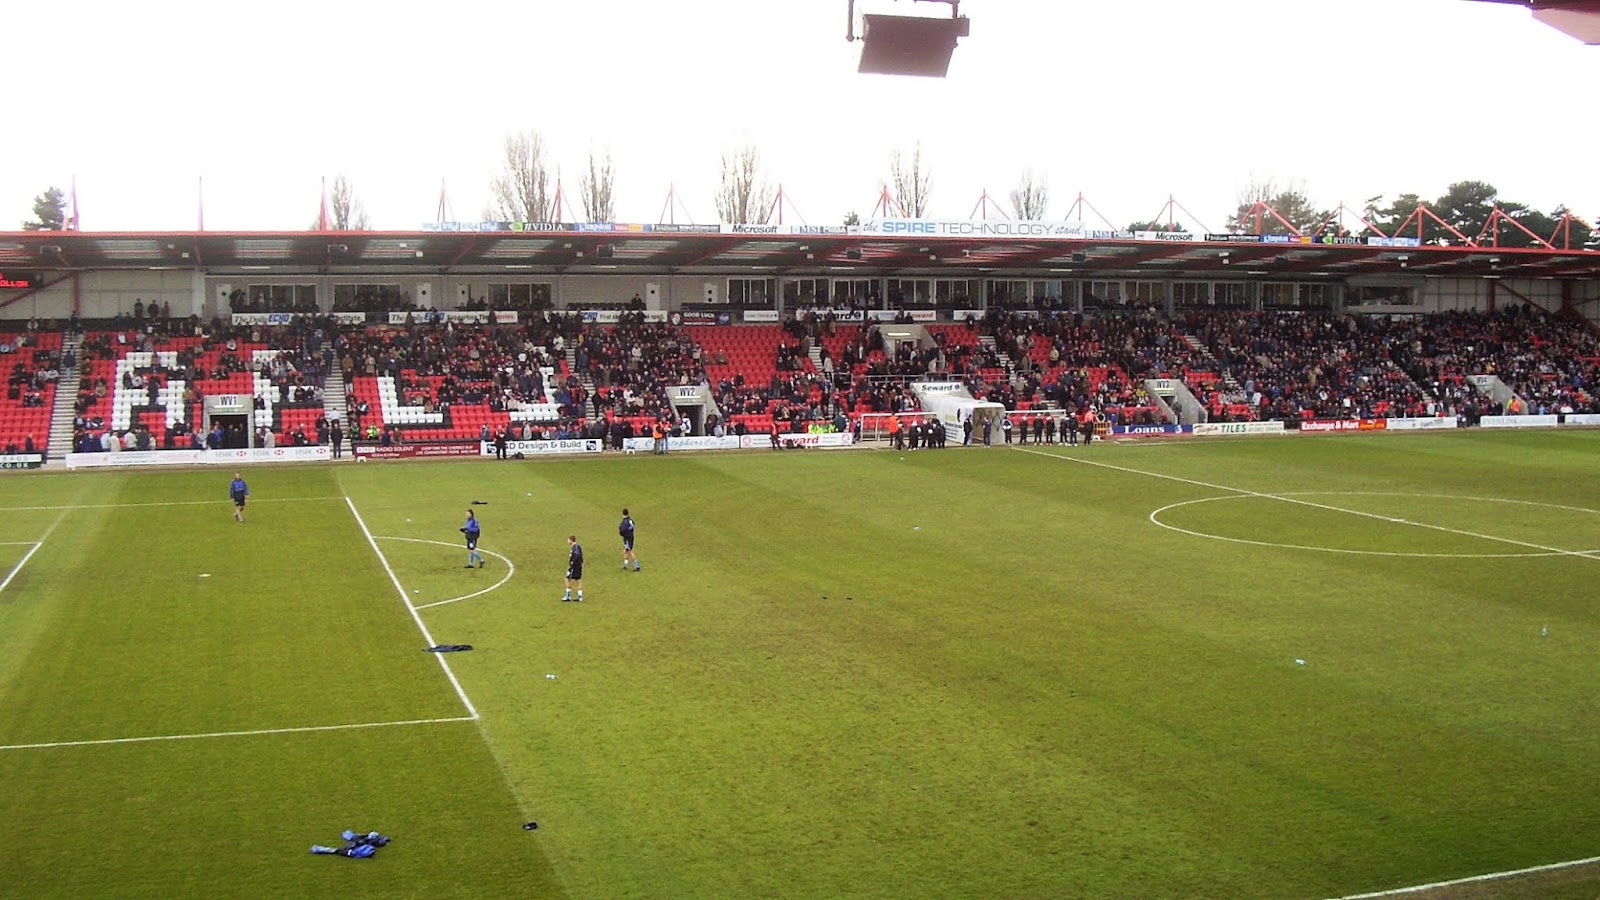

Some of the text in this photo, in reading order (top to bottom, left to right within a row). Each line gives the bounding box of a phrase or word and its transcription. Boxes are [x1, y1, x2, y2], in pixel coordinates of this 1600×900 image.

[732, 225, 777, 233] Microsoft
[882, 222, 936, 233] SPIRE
[939, 222, 1053, 235] TECHNOLOGY
[1155, 232, 1193, 241] Microsoft
[268, 314, 289, 322] ECHO
[680, 387, 696, 396] WV2
[220, 396, 238, 405] WV1
[1124, 425, 1165, 434] Loans
[1221, 424, 1246, 433] TILES
[1302, 421, 1334, 430] Exchange
[518, 442, 549, 450] Design
[550, 441, 558, 449] &
[560, 440, 582, 448] Build
